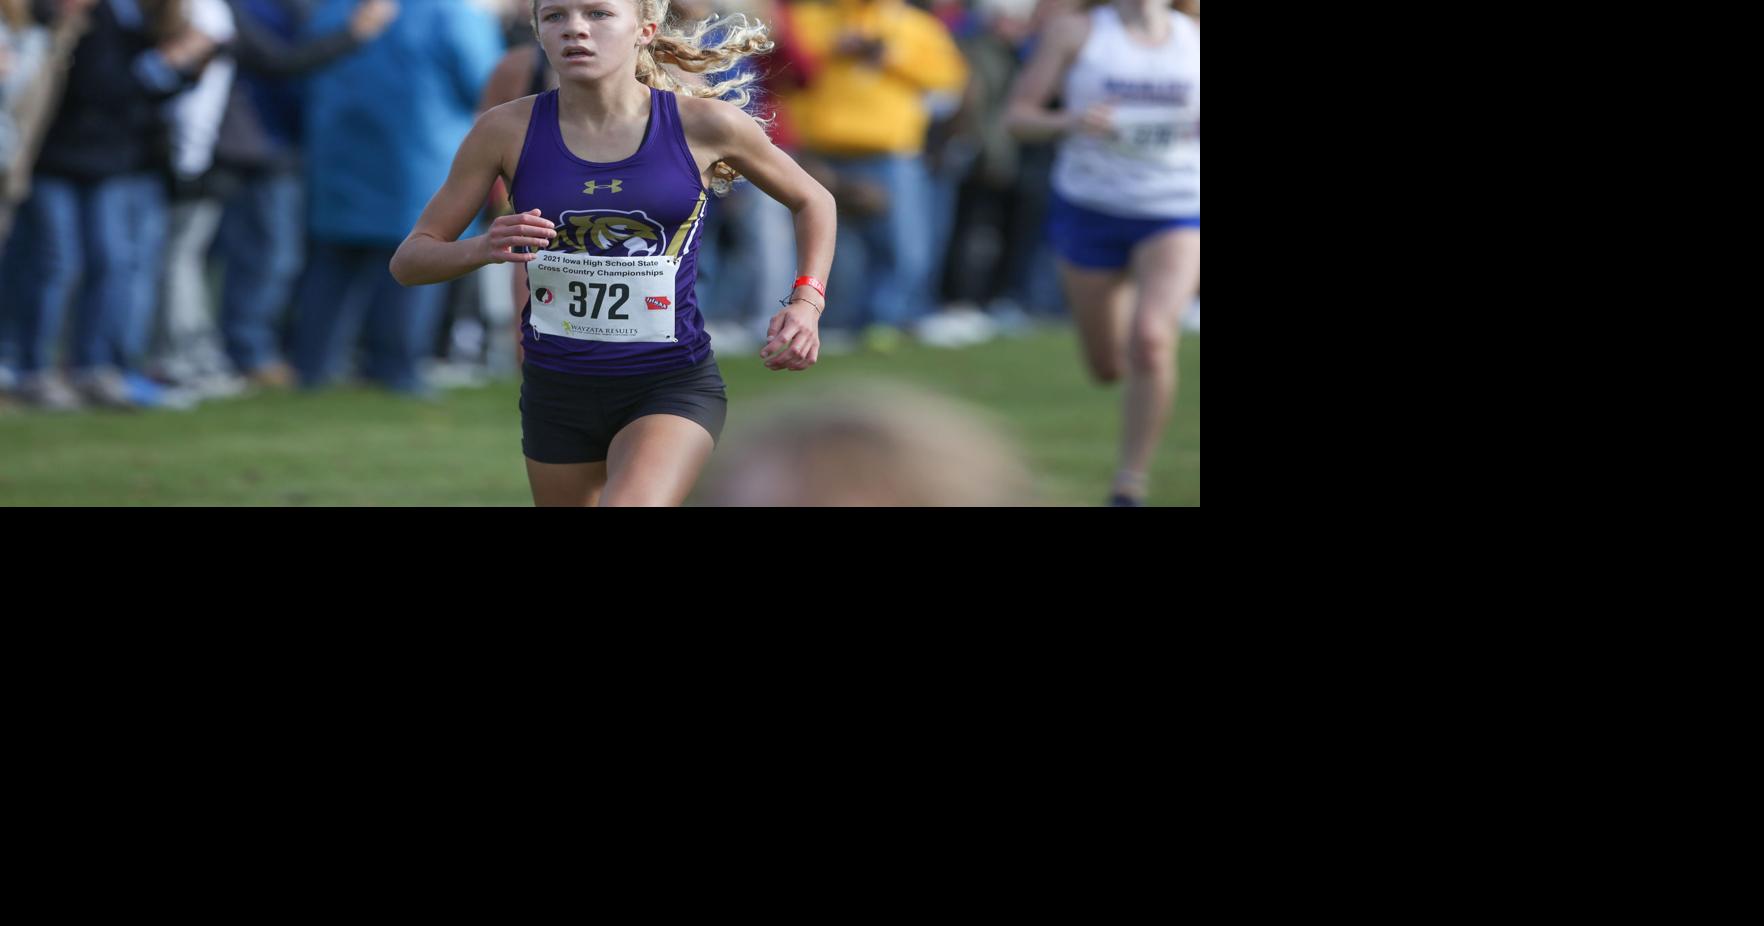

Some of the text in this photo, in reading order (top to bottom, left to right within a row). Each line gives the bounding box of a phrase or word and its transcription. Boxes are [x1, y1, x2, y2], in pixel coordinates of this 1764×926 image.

[543, 254, 560, 262] 2021
[562, 257, 581, 265] Iowa
[583, 259, 603, 267] High
[538, 263, 664, 277] Cross Country Championships
[568, 281, 630, 320] 372
[571, 323, 604, 334] WAYZATA
